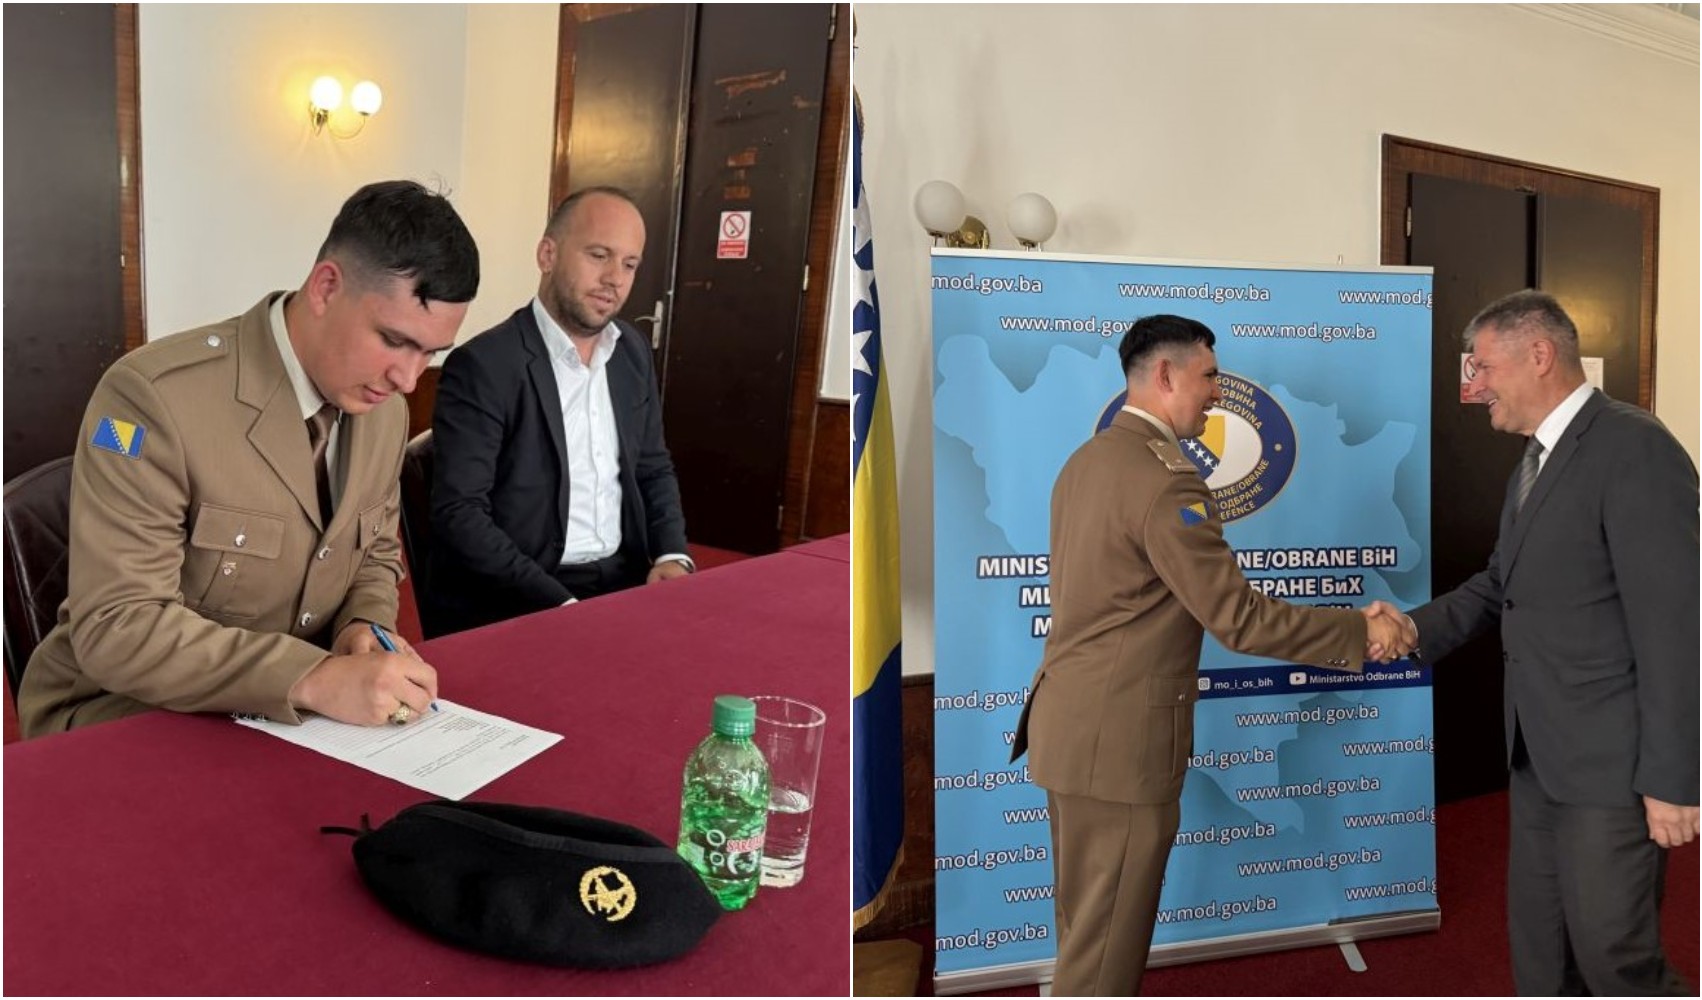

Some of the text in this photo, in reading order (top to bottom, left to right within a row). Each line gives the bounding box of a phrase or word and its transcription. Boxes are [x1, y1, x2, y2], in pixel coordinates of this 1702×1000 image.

[1119, 283, 1271, 304] www.mod.gov.ba
[1339, 290, 1433, 308] www.mod.g
[1001, 316, 1135, 337] www.mod.gov
[1231, 322, 1377, 342] www.mod.gov.ba
[1215, 375, 1254, 396] GOVINA
[1219, 386, 1257, 410] ОВИНА
[1211, 458, 1270, 500] RANE/OBRANE
[1220, 500, 1256, 520] EFENCE
[977, 555, 1051, 578] MINIS
[1235, 546, 1397, 569] NE/OBRANE BiH
[1248, 576, 1363, 597] БРАНЕ БиХ
[1213, 677, 1274, 691] mo_i_os_bih
[1309, 670, 1421, 684] Ministarstvo Odbrane BiH
[1235, 703, 1380, 727] www.mod.gov.ba
[1343, 735, 1434, 757] www.mod.g
[934, 766, 1034, 791] mod.gov.b
[1237, 775, 1381, 801] www.mod.gov.ba
[1003, 807, 1050, 824] www
[1344, 805, 1436, 829] www.mod.g
[1237, 847, 1382, 876] www.mod.gov.ba
[1003, 885, 1057, 903] www
[1345, 875, 1437, 901] www.mod.g
[1155, 895, 1277, 923] w.mod.gov.ba
